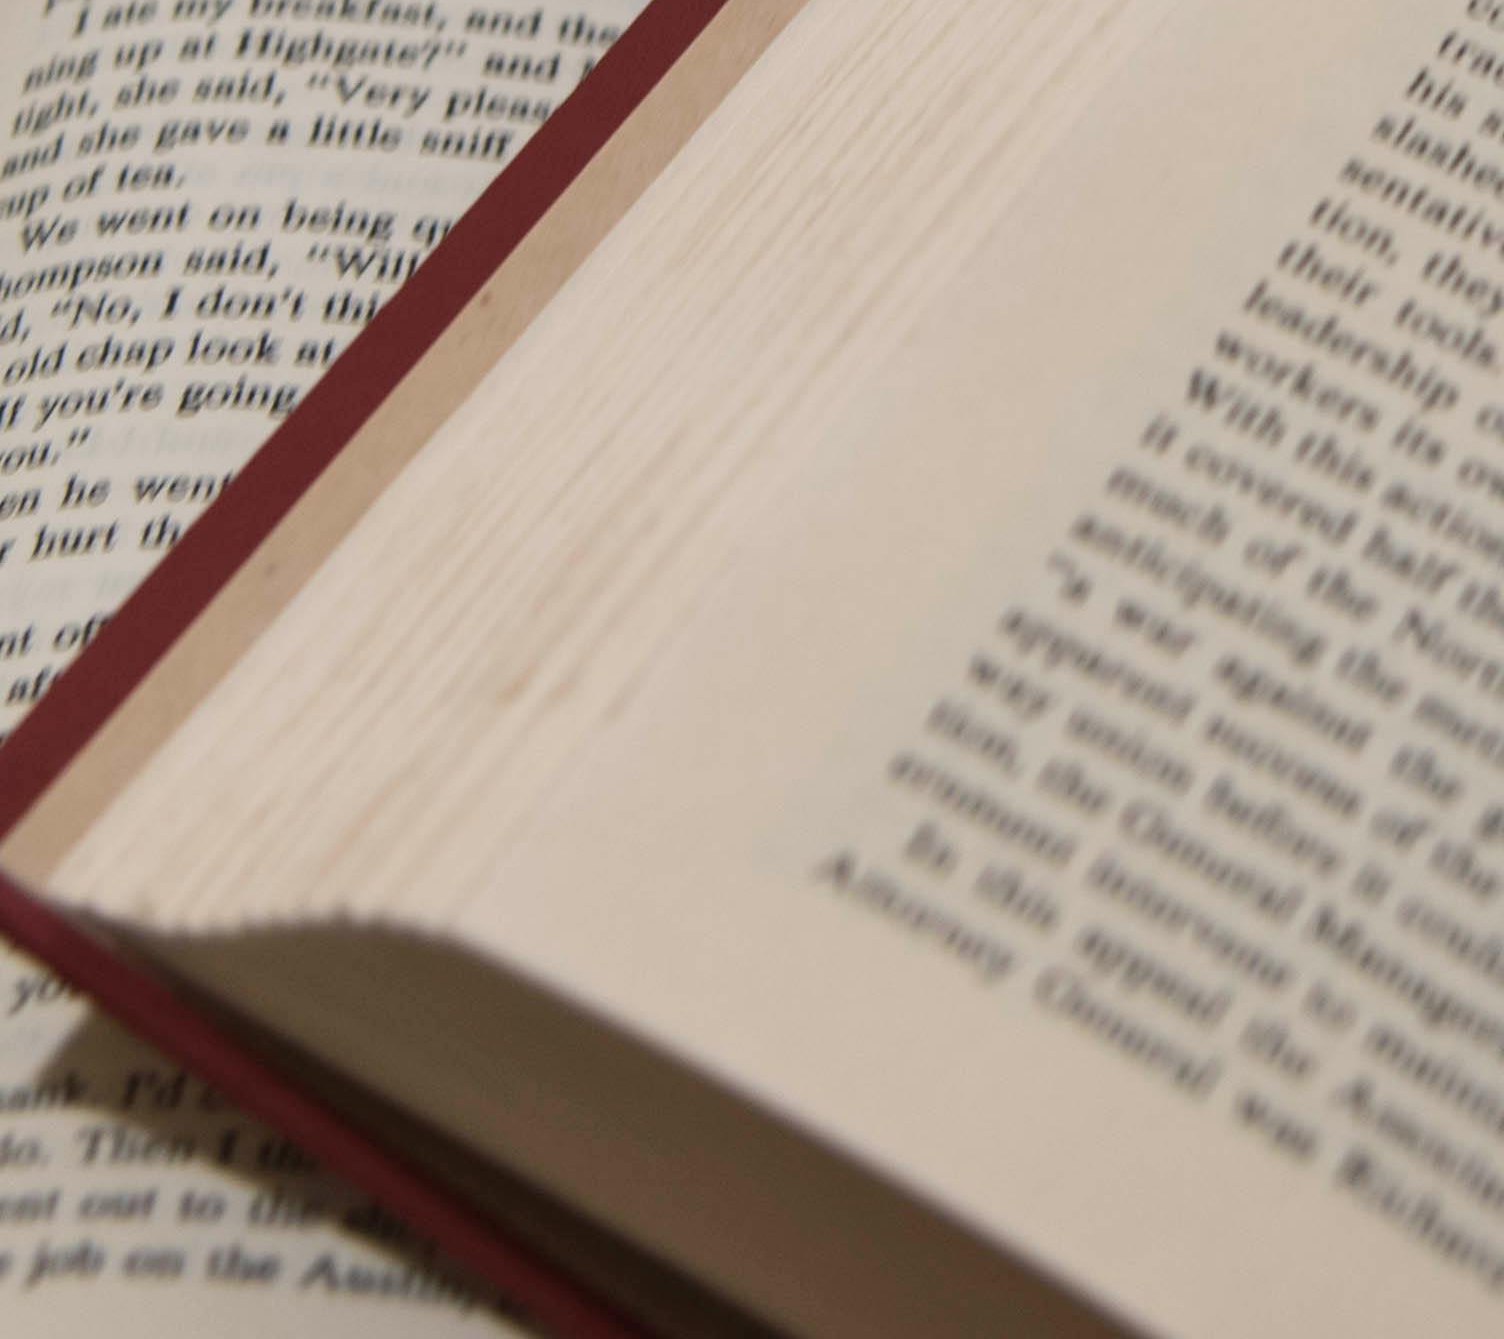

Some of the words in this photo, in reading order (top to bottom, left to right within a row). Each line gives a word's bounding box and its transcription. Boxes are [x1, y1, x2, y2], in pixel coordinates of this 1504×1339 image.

[462, 7, 546, 41] and
[75, 120, 143, 157] she
[151, 117, 252, 155] gave
[264, 118, 293, 147] a
[306, 113, 404, 152] little
[61, 163, 107, 203] of
[19, 212, 79, 254] We
[93, 200, 193, 239] went
[205, 204, 263, 232] on
[279, 196, 397, 245] being
[159, 284, 185, 322] I
[1, 340, 68, 389] old
[74, 333, 176, 375] chap
[184, 328, 279, 367] look
[174, 373, 300, 420] going
[58, 472, 113, 511] he
[28, 519, 120, 563] hurt
